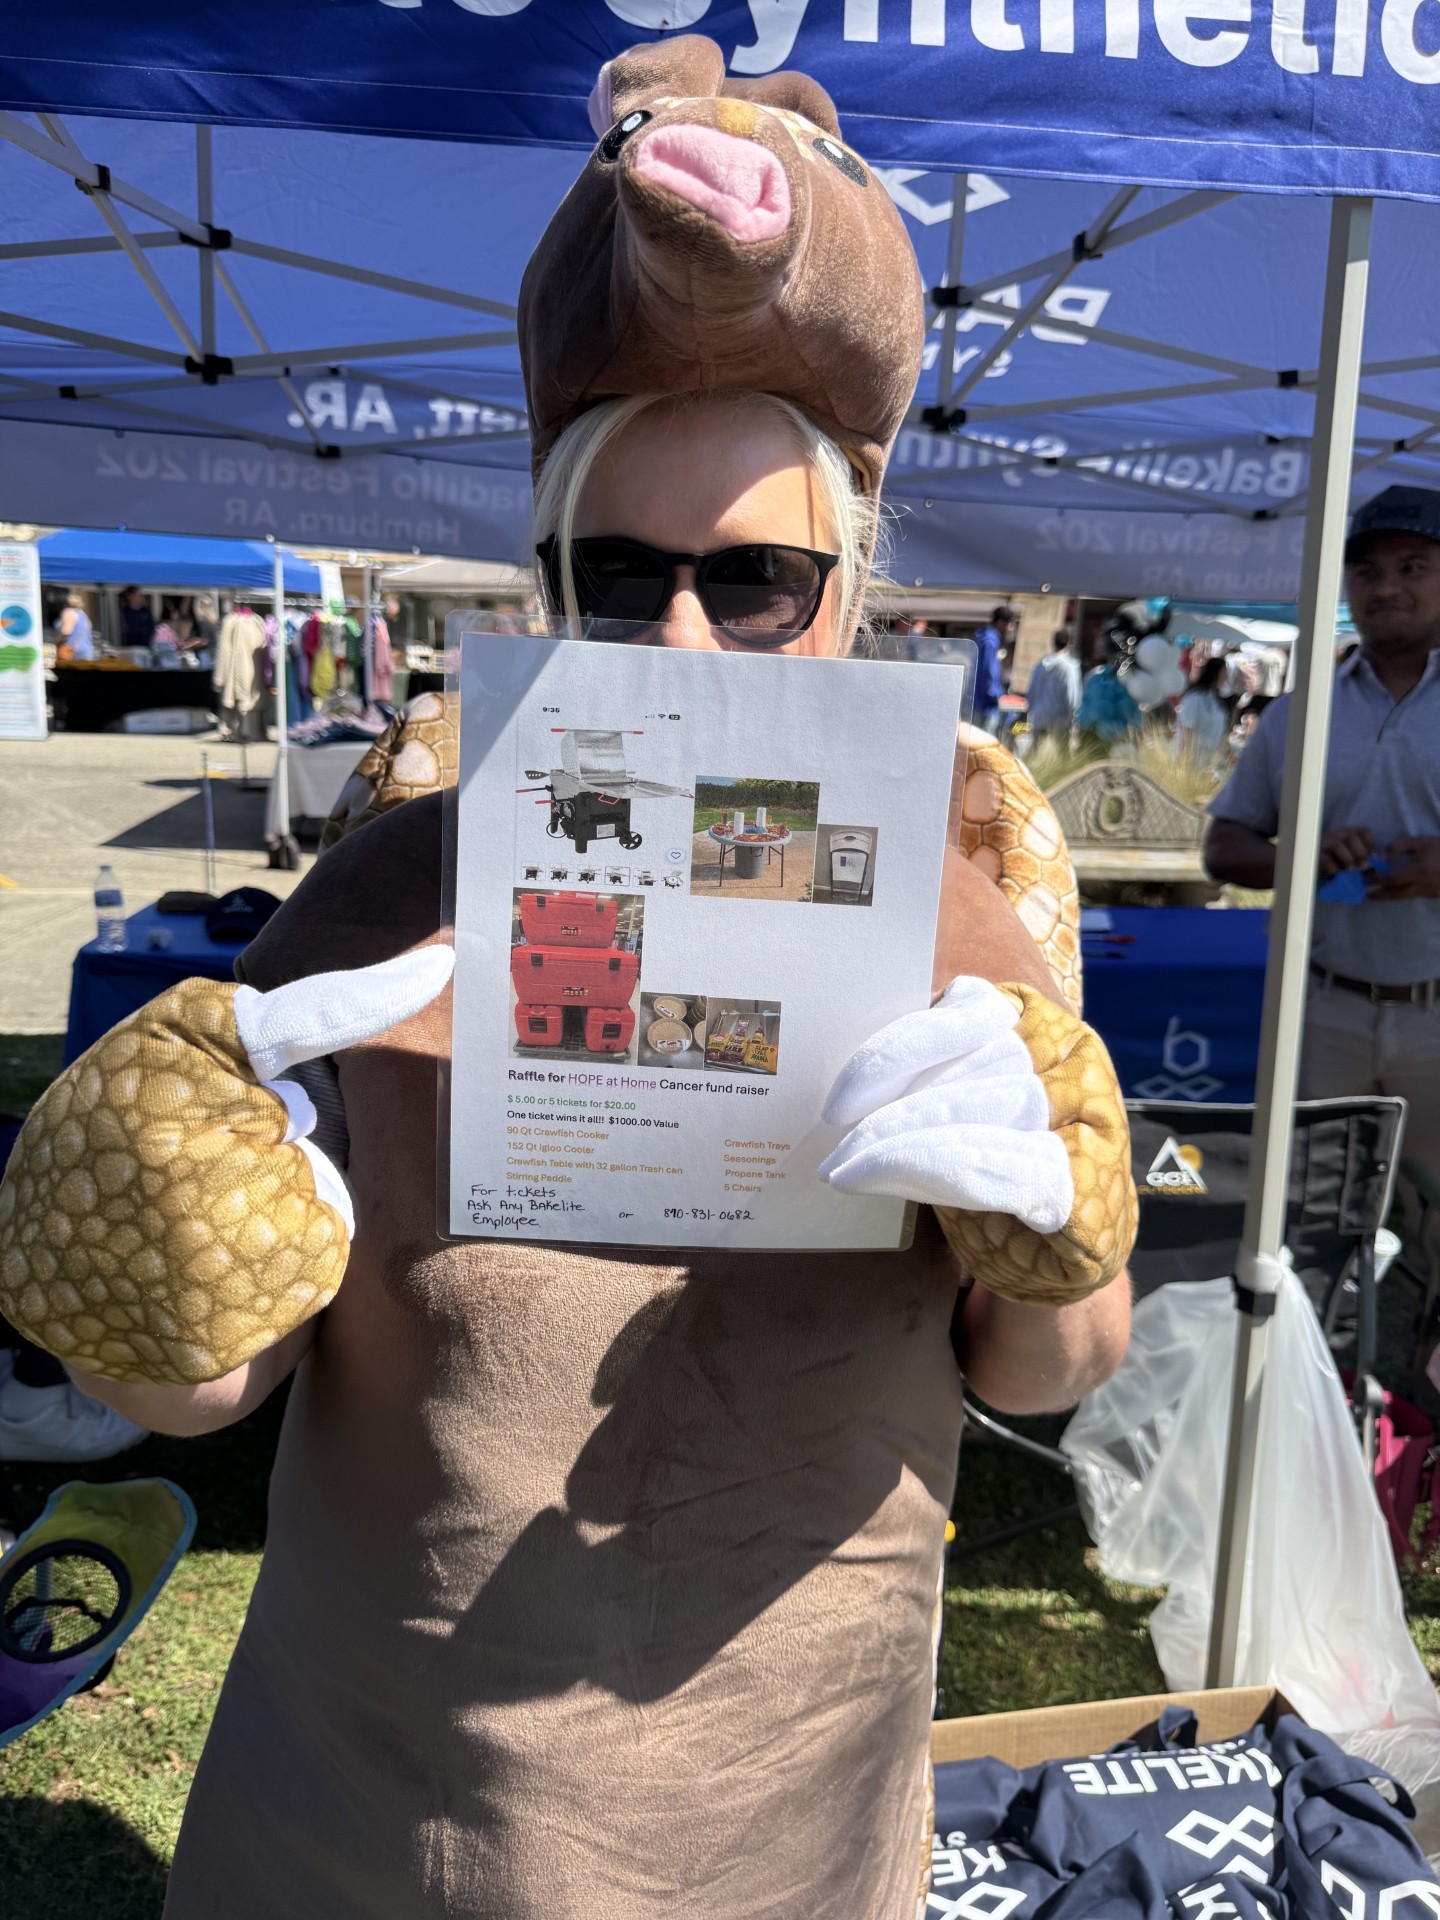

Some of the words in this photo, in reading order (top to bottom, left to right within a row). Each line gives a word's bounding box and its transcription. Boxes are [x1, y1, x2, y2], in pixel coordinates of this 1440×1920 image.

[508, 1070, 545, 1082] Raffle
[548, 1072, 566, 1083] for
[568, 1073, 604, 1086] HOPE
[606, 1077, 618, 1086] at
[620, 1077, 656, 1089] Home
[660, 1079, 703, 1091] Cancer
[706, 1082, 733, 1093] fund
[736, 1085, 770, 1096] raiser
[515, 1096, 536, 1104] 5.00
[557, 1098, 588, 1108] tickets
[590, 1100, 602, 1108] for
[604, 1101, 636, 1110] $20.00
[507, 1110, 526, 1119] One
[528, 1112, 554, 1121] ticket
[556, 1114, 577, 1122] wins
[580, 1114, 586, 1122] it
[588, 1116, 604, 1124] all!!
[608, 1116, 652, 1126] $1000.00
[654, 1120, 679, 1128] Value
[506, 1126, 518, 1134] 90
[520, 1127, 532, 1136] Qt
[534, 1128, 574, 1138] Crawfish
[576, 1130, 609, 1140] Cooker
[507, 1142, 524, 1150] 152
[526, 1142, 537, 1151] Qt
[539, 1144, 561, 1153] Igloo
[564, 1145, 594, 1154] Cooler
[724, 1139, 765, 1149] Crawfish
[767, 1142, 792, 1152] Trays
[506, 1156, 547, 1166] Crawfish
[549, 1159, 574, 1168] Table
[575, 1161, 594, 1170] with
[596, 1162, 608, 1170] 32
[610, 1163, 638, 1172] gallon
[639, 1164, 664, 1174] Trash
[666, 1167, 683, 1175] can
[723, 1154, 777, 1166] Seasonings
[506, 1172, 539, 1182] Stirring
[541, 1174, 572, 1184] Paddle
[725, 1168, 763, 1180] Propane
[765, 1170, 787, 1179] Tank
[471, 1183, 498, 1196] For
[724, 1184, 730, 1192] 5
[732, 1184, 762, 1192] Chairs
[500, 1200, 523, 1214] Any
[472, 1212, 540, 1230] Employee
